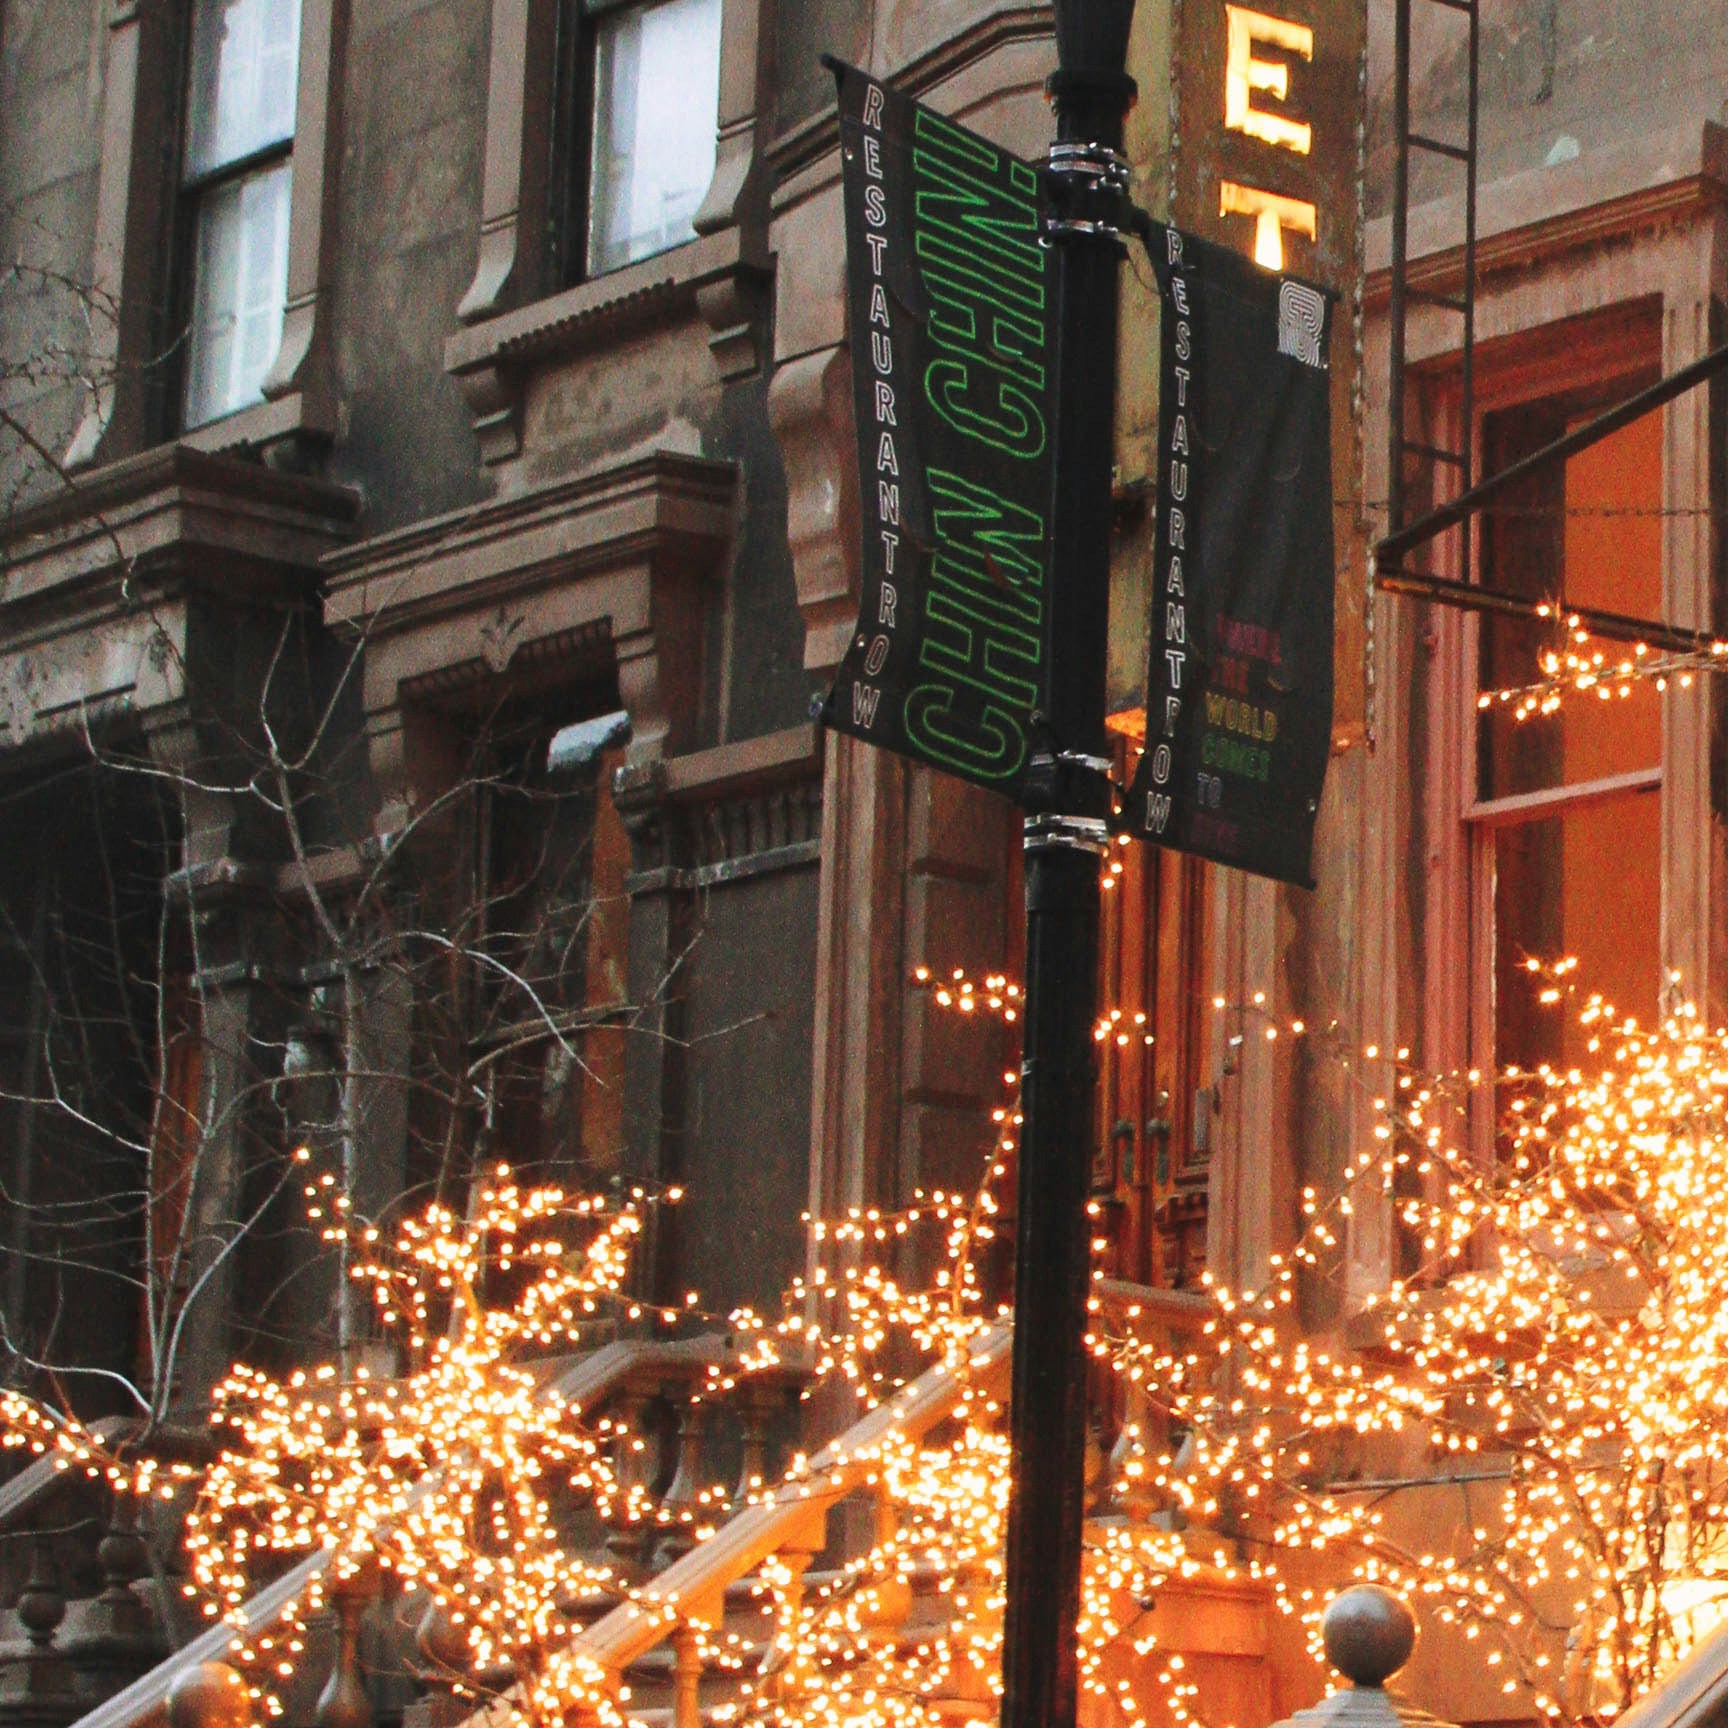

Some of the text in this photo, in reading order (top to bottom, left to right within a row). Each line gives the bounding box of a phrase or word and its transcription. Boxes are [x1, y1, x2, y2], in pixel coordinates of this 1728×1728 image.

[852, 83, 899, 730] RESTAURANT ROW
[905, 110, 1046, 778] CHIN CHIN!
[1144, 229, 1191, 834] RESTAURANT ROW
[1196, 772, 1223, 810] TO
[1201, 733, 1271, 783] COMES
[1204, 690, 1278, 742] WORLD
